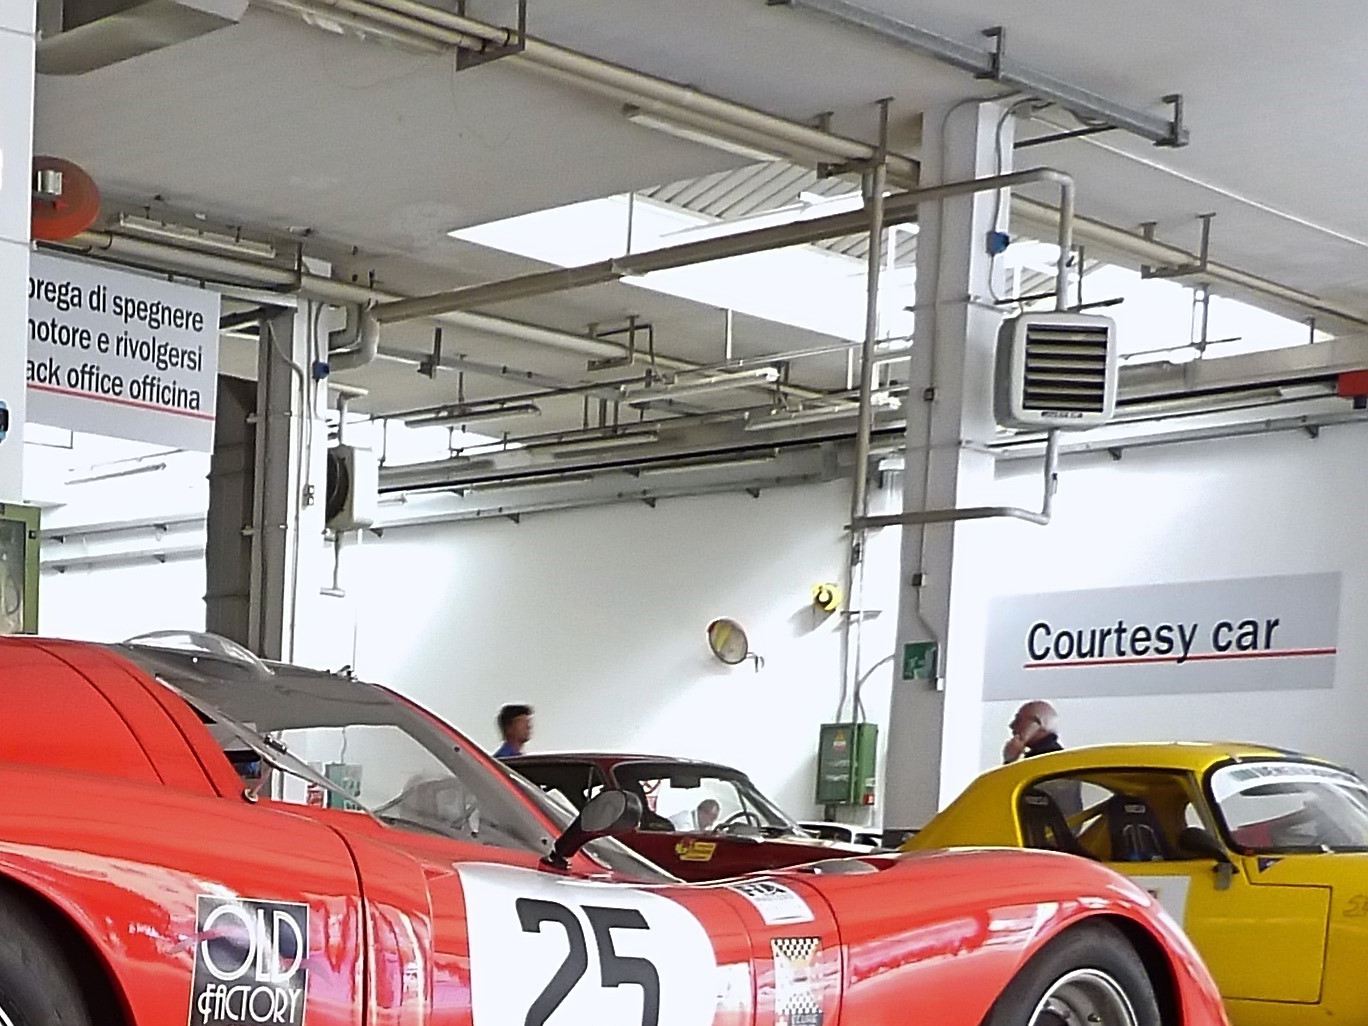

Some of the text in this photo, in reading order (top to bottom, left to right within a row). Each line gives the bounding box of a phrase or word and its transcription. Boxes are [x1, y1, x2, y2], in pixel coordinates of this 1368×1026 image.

[89, 285, 107, 313] di
[113, 294, 203, 332] spegnere
[97, 333, 110, 353] e
[116, 331, 202, 372] rivolgersi
[26, 357, 200, 410] ack office officina
[1027, 618, 1280, 663] Courtesy car
[201, 904, 304, 983] OLD
[197, 983, 302, 1025] FACTORY
